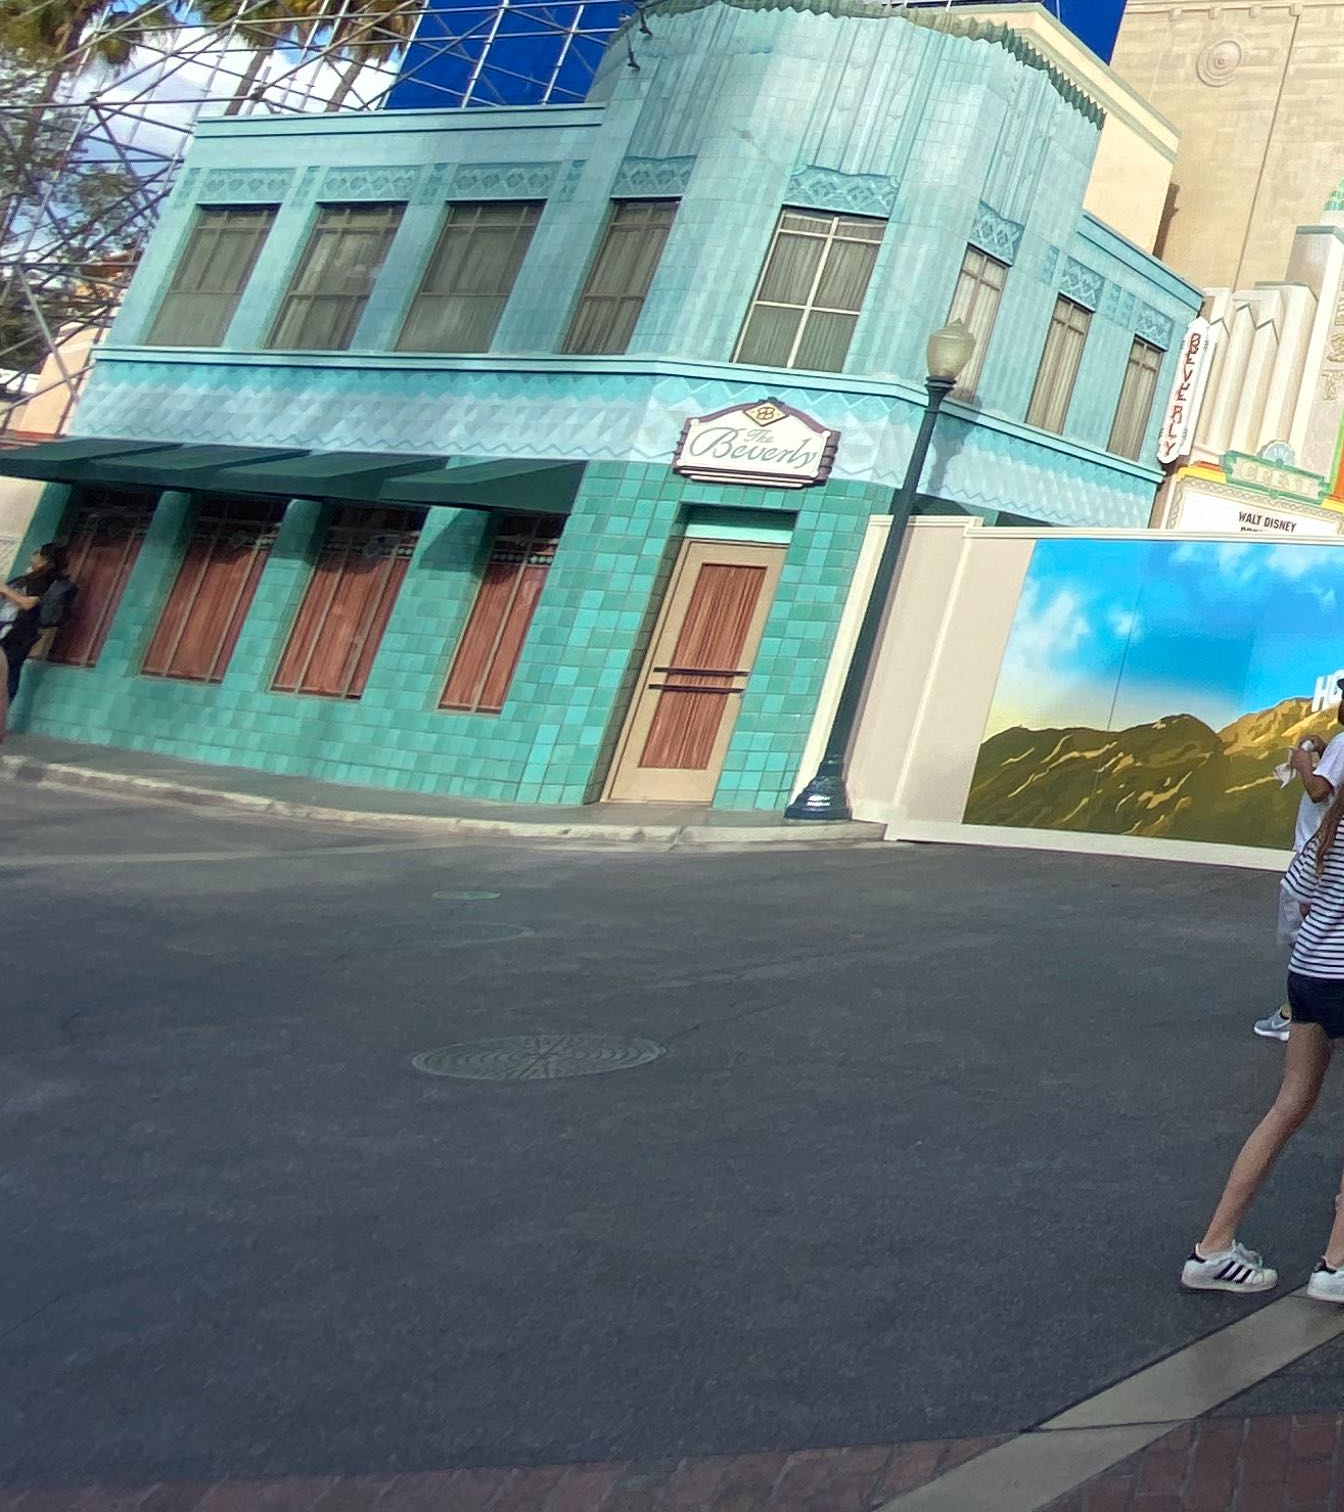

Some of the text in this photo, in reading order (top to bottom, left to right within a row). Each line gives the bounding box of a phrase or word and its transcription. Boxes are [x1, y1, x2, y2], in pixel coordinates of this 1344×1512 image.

[1164, 332, 1202, 457] BEVERLY
[689, 426, 818, 470] Beverly
[744, 428, 774, 444] The
[1238, 511, 1297, 533] WALT DISNEY
